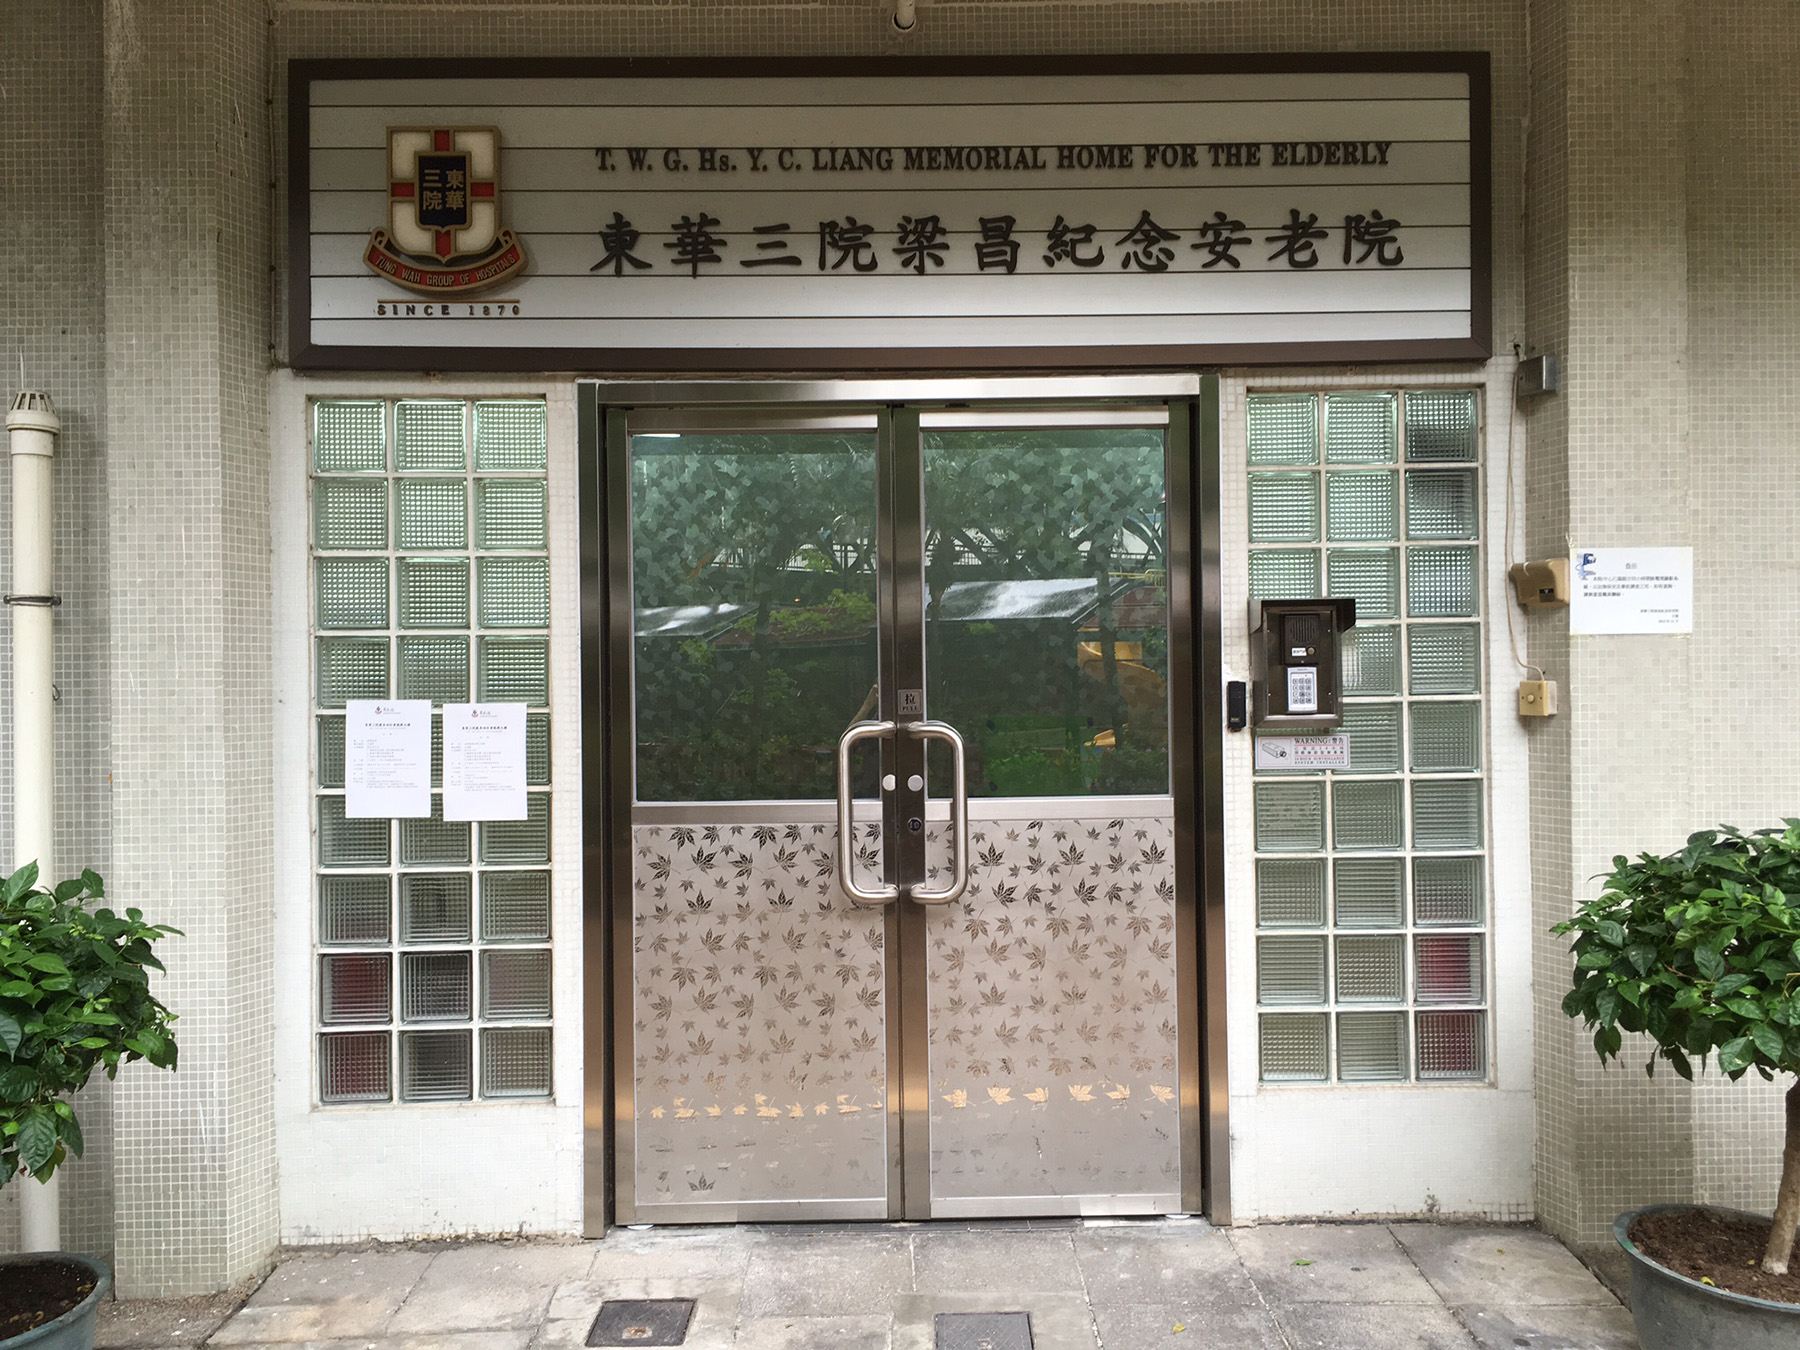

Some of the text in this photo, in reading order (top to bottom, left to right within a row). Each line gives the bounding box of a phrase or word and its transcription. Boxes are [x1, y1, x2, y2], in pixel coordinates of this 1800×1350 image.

[812, 147, 893, 171] LIANG
[903, 146, 1047, 170] MEMORIAL
[1057, 145, 1133, 169] HOME
[1144, 144, 1199, 169] FOR
[1208, 143, 1261, 168] THE
[1271, 141, 1392, 167] ELDERLY
[590, 209, 1404, 278] 東華三院梁昌紀念安老院
[375, 254, 515, 286] TUNG WAH GROUP OF HOSPITALS
[377, 304, 520, 316] SINCE 1870
